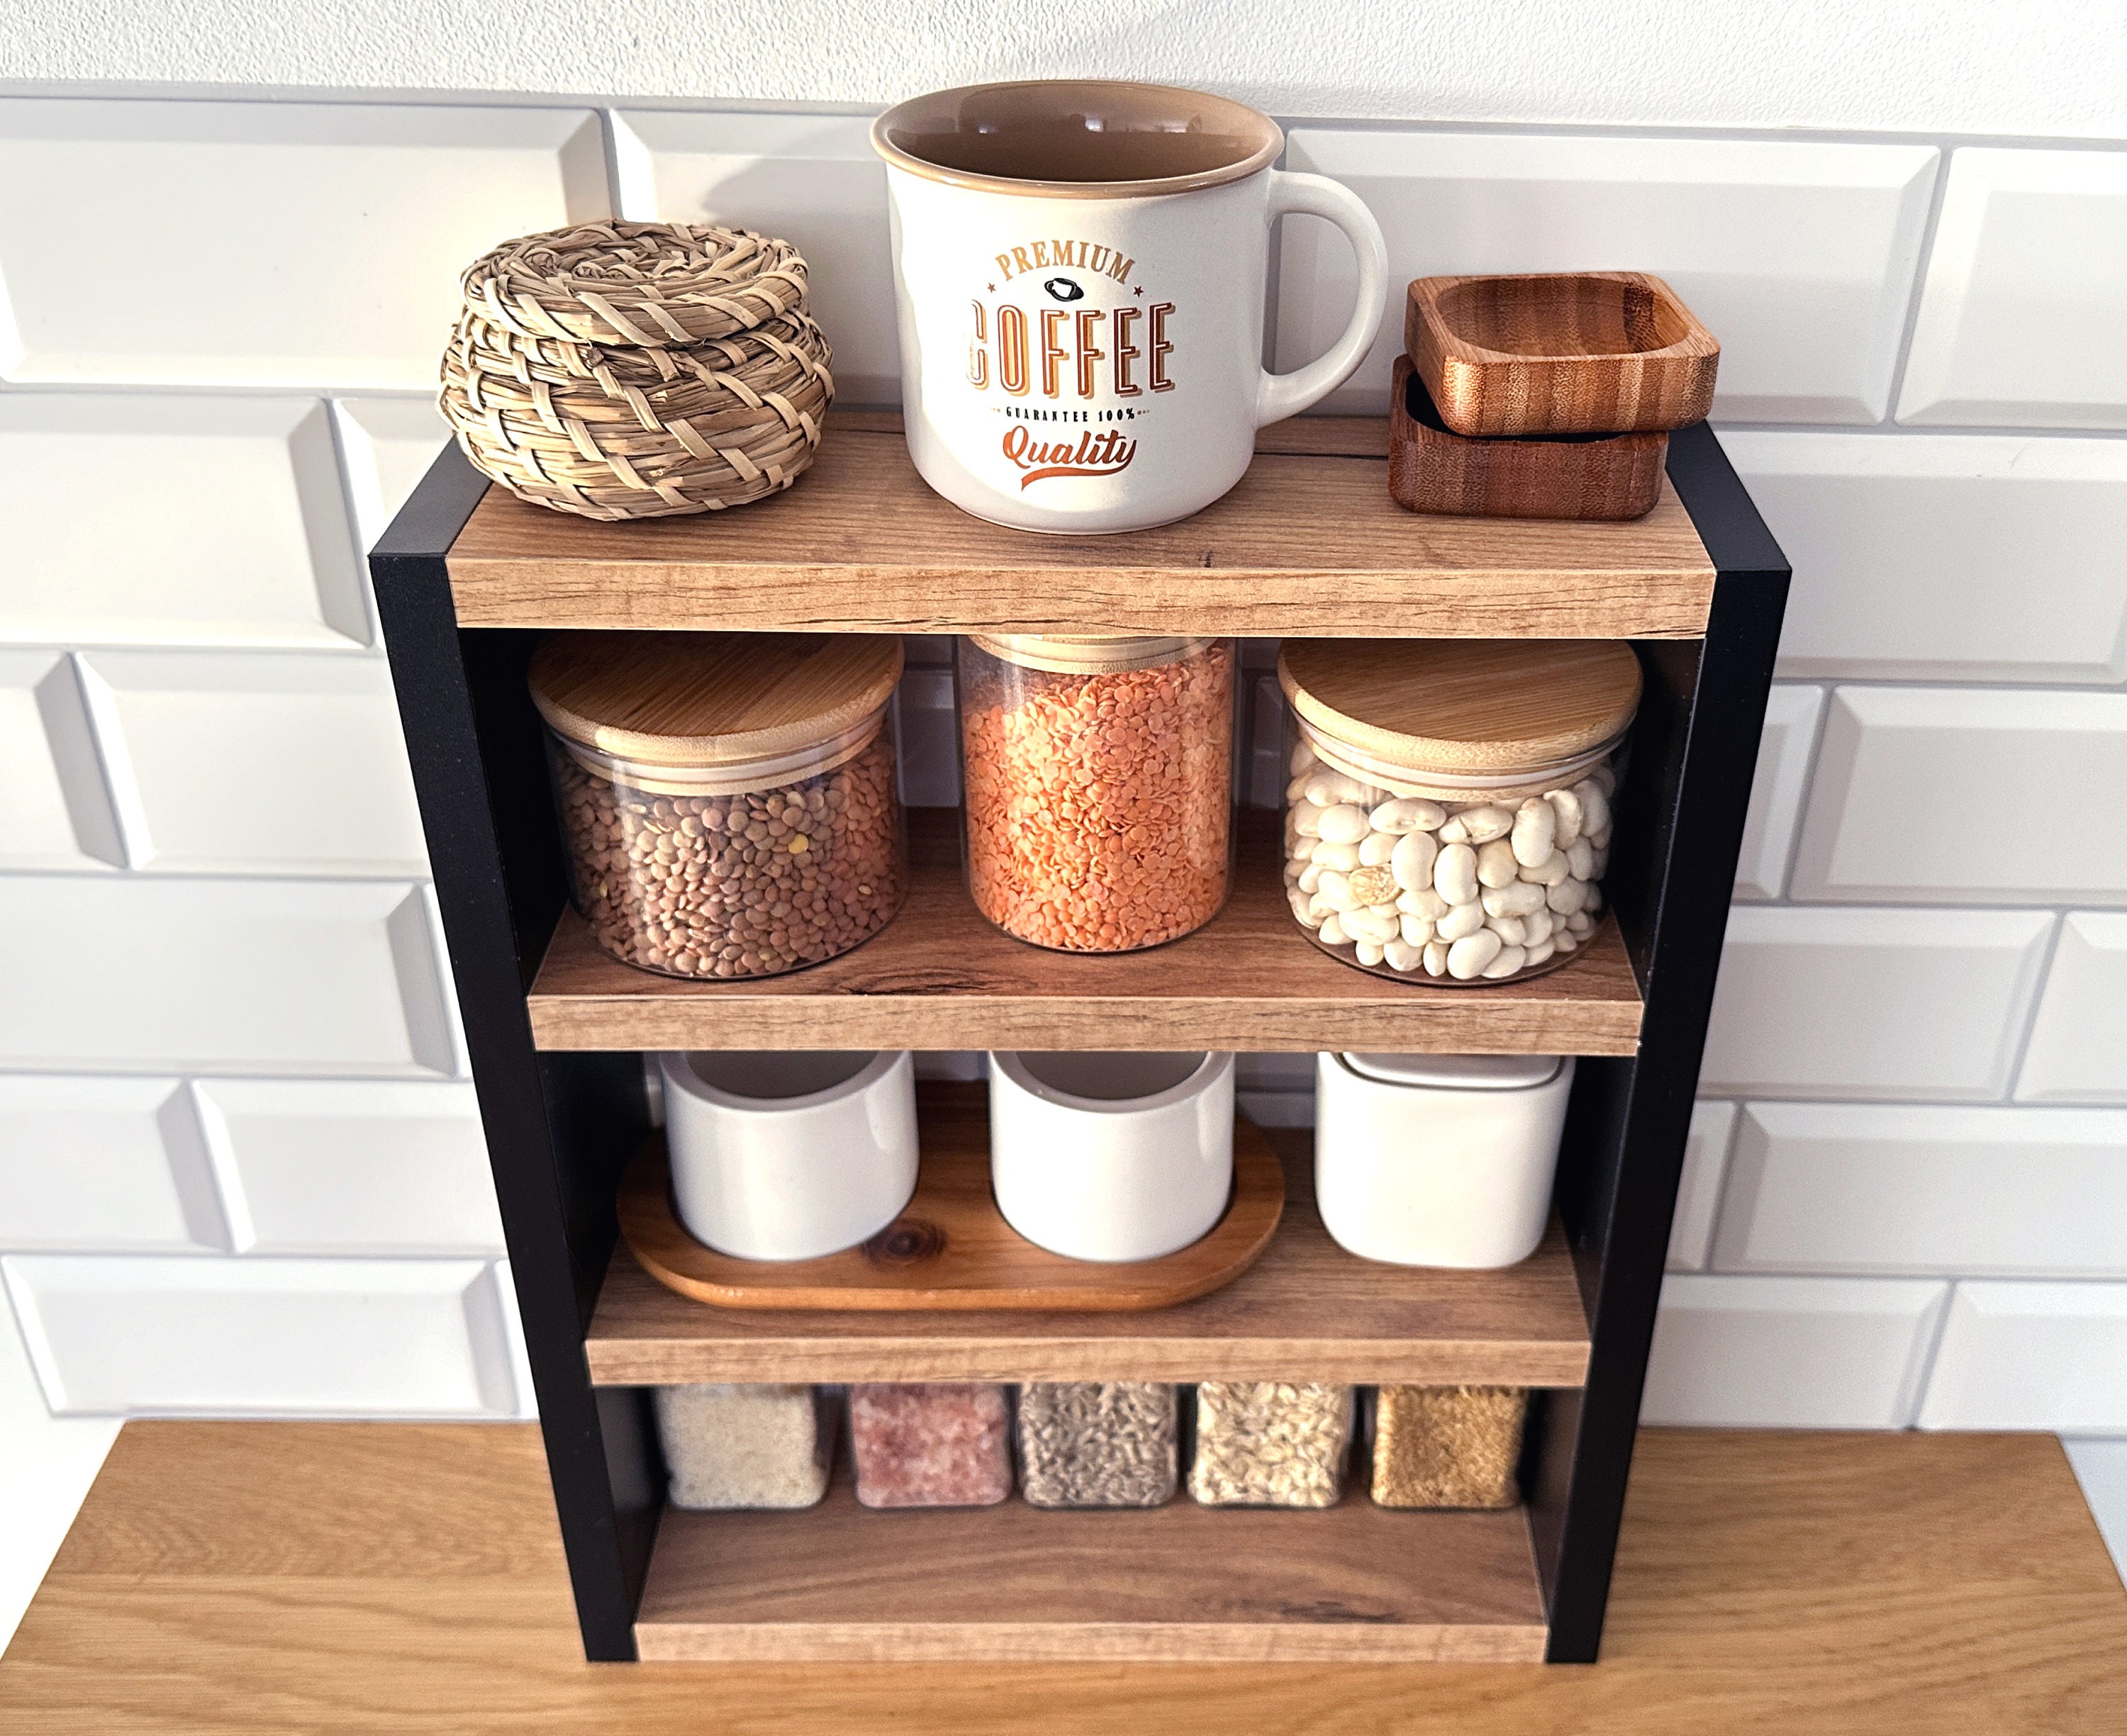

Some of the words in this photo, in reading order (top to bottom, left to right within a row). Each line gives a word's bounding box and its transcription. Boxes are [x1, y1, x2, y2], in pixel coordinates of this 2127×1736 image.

[995, 240, 1135, 284] PREMIUM
[966, 299, 1176, 400] COFFEE
[1006, 406, 1088, 422] GUARANTEE
[1098, 408, 1135, 423] 100%
[1003, 425, 1137, 491] Quality
